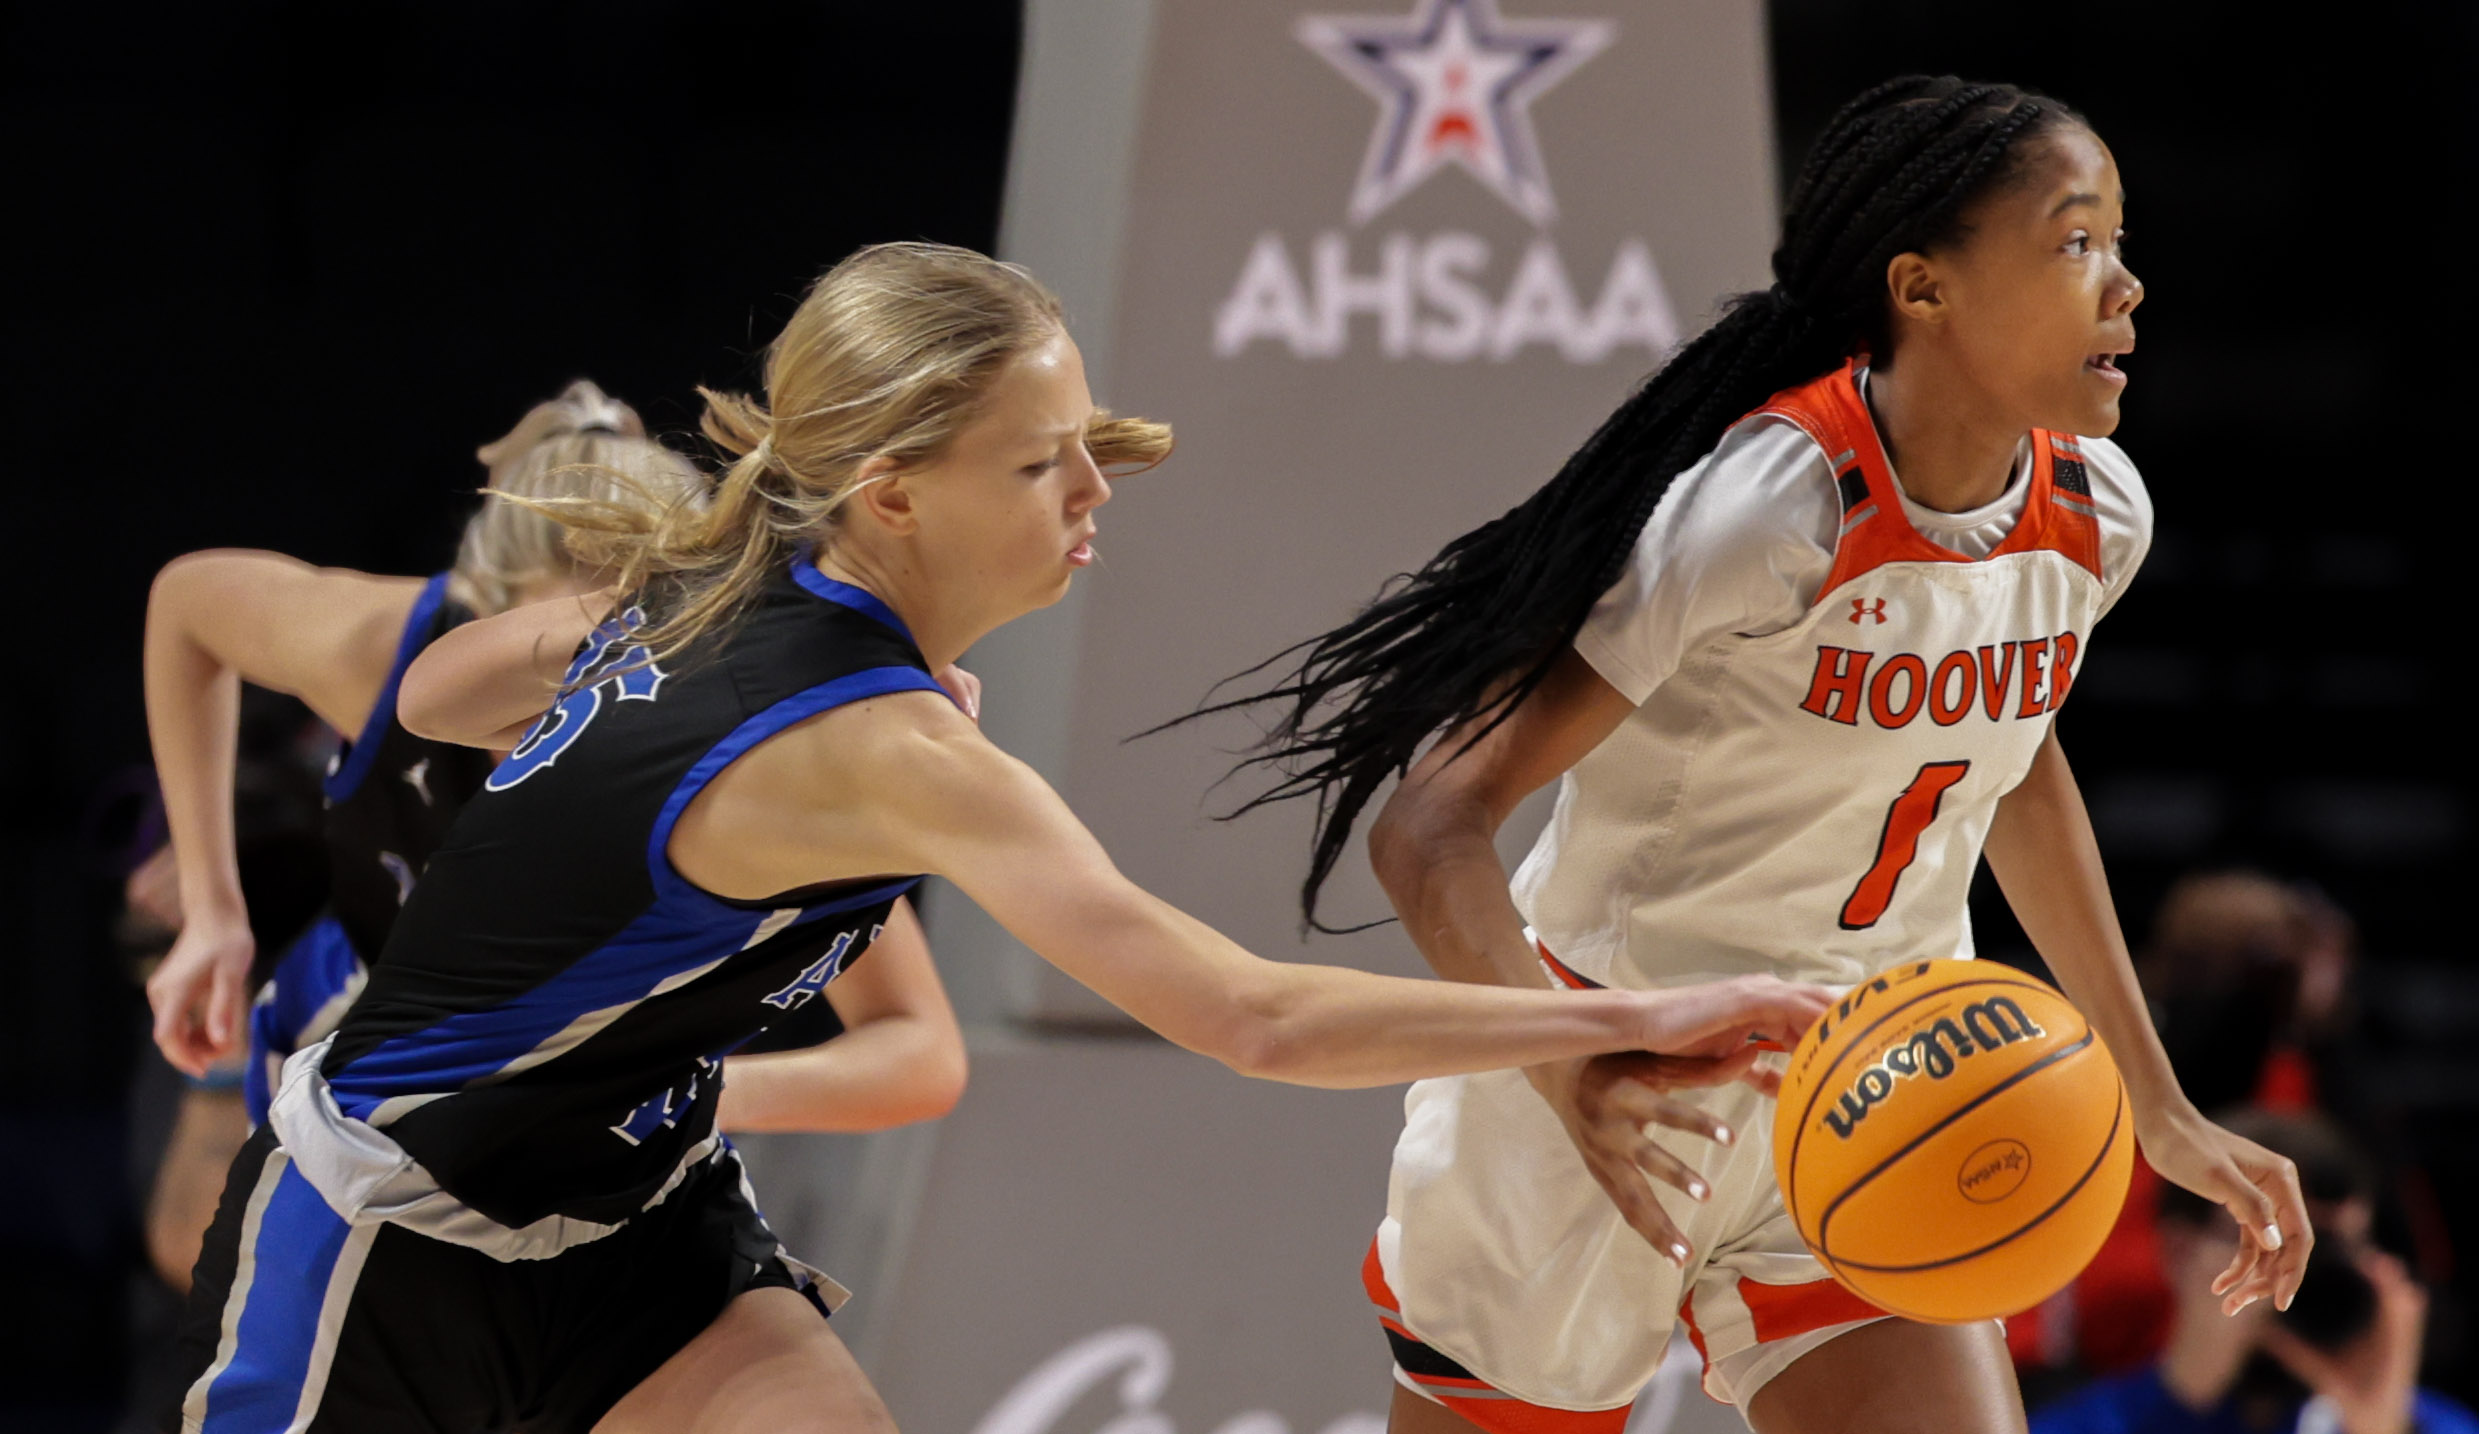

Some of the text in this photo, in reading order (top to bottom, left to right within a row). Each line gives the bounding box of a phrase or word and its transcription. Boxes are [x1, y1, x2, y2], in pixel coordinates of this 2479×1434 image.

[1213, 229, 1680, 364] AHSAA
[1799, 630, 2079, 730] HOOVER
[1838, 759, 1971, 931] 1
[1822, 995, 2046, 1139] Wilson
